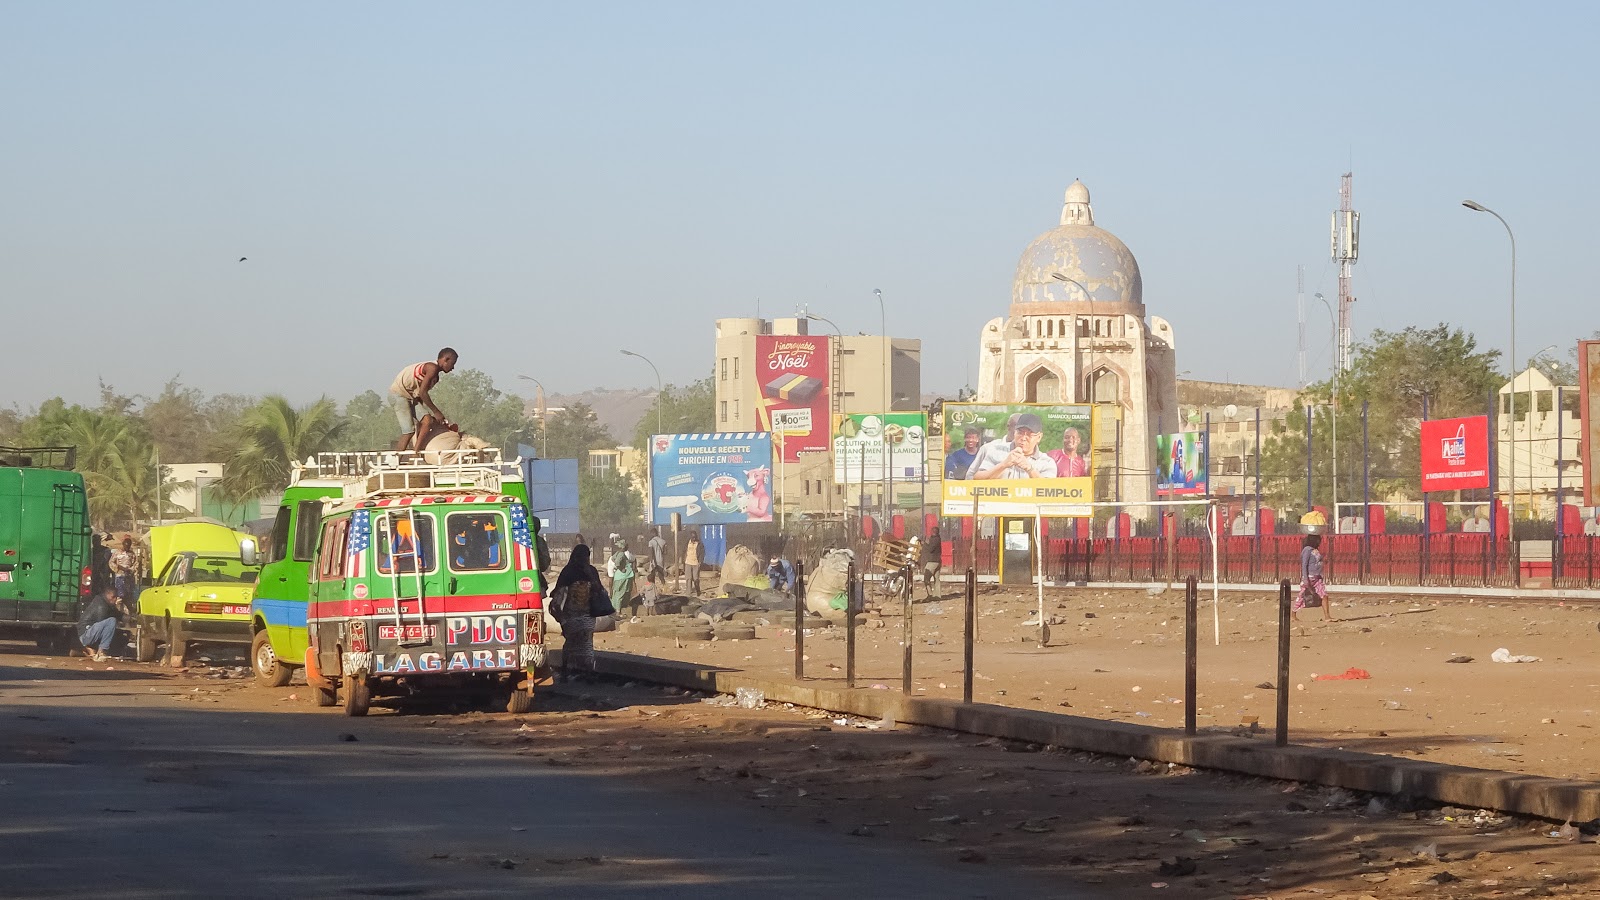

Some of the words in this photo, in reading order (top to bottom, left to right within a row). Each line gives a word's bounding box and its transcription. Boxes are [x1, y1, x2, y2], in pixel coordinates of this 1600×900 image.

[769, 353, 809, 370] Noël
[678, 446, 717, 455] NOUVELLE
[718, 445, 751, 454] RECETTE
[678, 456, 715, 465] ENRICHIE
[716, 456, 727, 464] EN
[949, 486, 967, 496] UN
[1015, 487, 1033, 497] UN
[377, 606, 409, 614] RENALT
[446, 615, 517, 646] PDG
